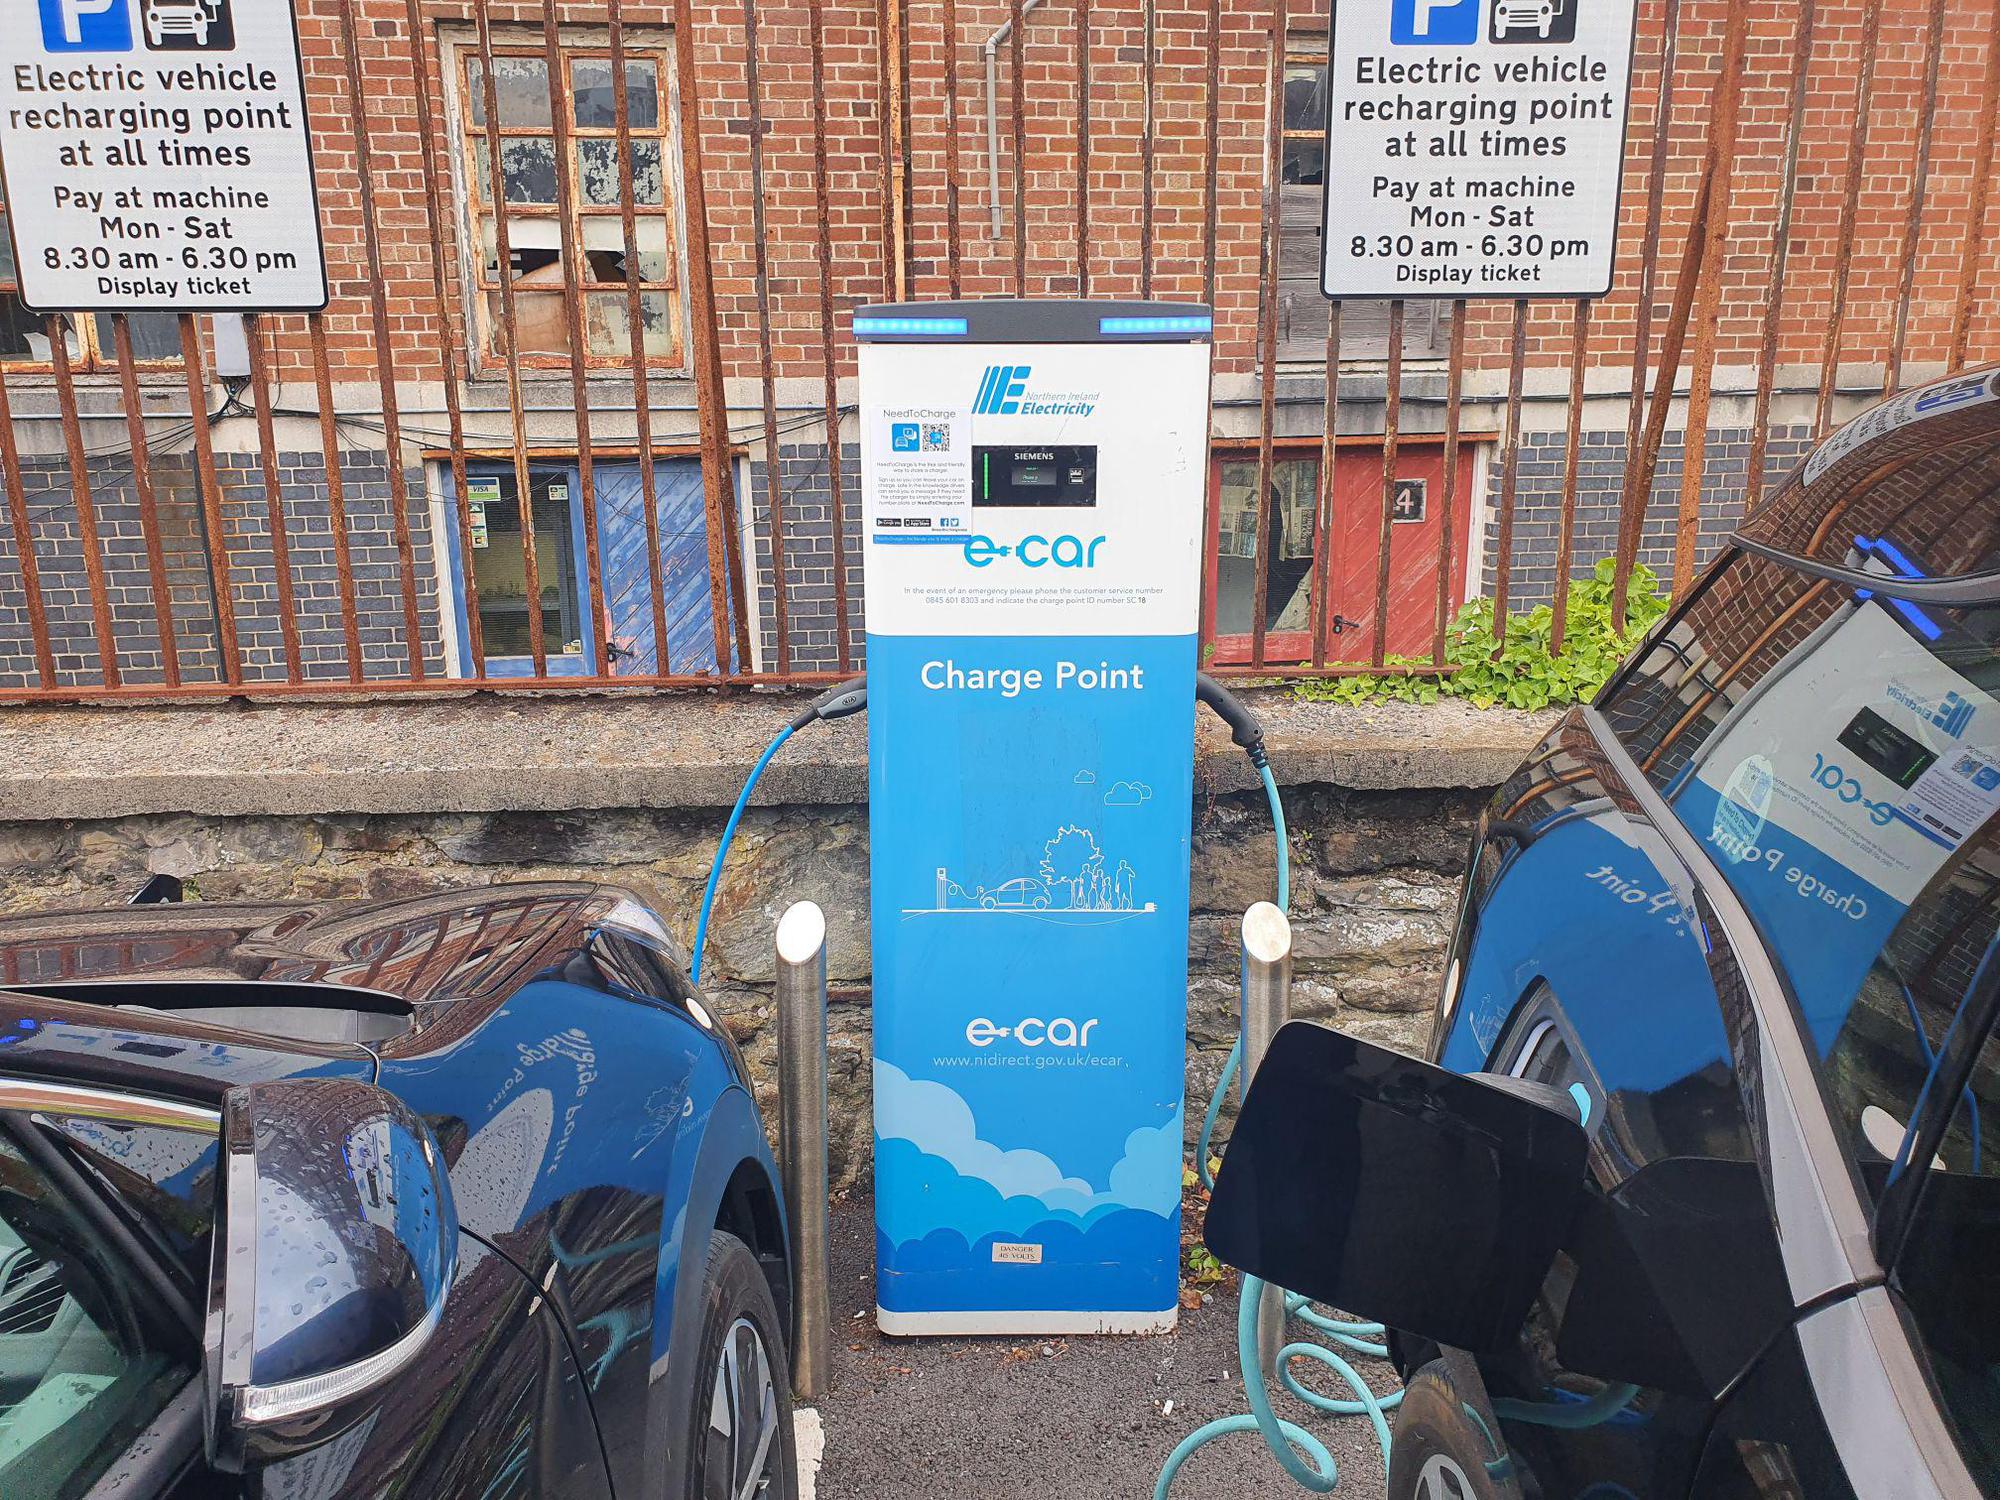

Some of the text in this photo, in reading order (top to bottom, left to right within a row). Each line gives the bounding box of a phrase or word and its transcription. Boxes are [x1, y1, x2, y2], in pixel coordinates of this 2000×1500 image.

[14, 62, 277, 92] Electric vehicle
[1357, 55, 1607, 84] Electric vehicle
[9, 101, 292, 134] recharging point
[1344, 92, 1613, 125] recharging point
[59, 139, 252, 166] at all times
[1385, 130, 1567, 157] at all times
[54, 186, 270, 212] Pay at machine
[1373, 175, 1576, 202] Pay at machine
[100, 217, 160, 239] Mon
[184, 216, 234, 239] Sat
[1410, 206, 1465, 227] Mon
[1488, 205, 1535, 227] Sat
[1350, 235, 1414, 257] 8.30
[1421, 240, 1458, 257] am
[1481, 234, 1543, 257] 6.30
[1550, 239, 1590, 260] pm
[43, 246, 110, 270] 8.30
[118, 252, 159, 269] am
[182, 246, 248, 270] 6.30
[255, 251, 297, 274] pm
[1396, 264, 1541, 285] Display ticket
[98, 277, 252, 299] Display ticket
[1025, 391, 1100, 402] Northern Ireland
[883, 409, 957, 420] NeedToCharge
[1020, 402, 1096, 418] Electricity
[1014, 452, 1055, 461] SIEMENS
[968, 588, 1008, 596] emergency
[1010, 587, 1033, 596] please
[1035, 587, 1058, 596] phone
[1039, 597, 1064, 606] charge
[1066, 597, 1085, 606] point
[920, 659, 1144, 698] Charge Point
[932, 1053, 1123, 1069] www.nidirect.gov.uk/ecar
[1000, 1245, 1034, 1253] DANGER
